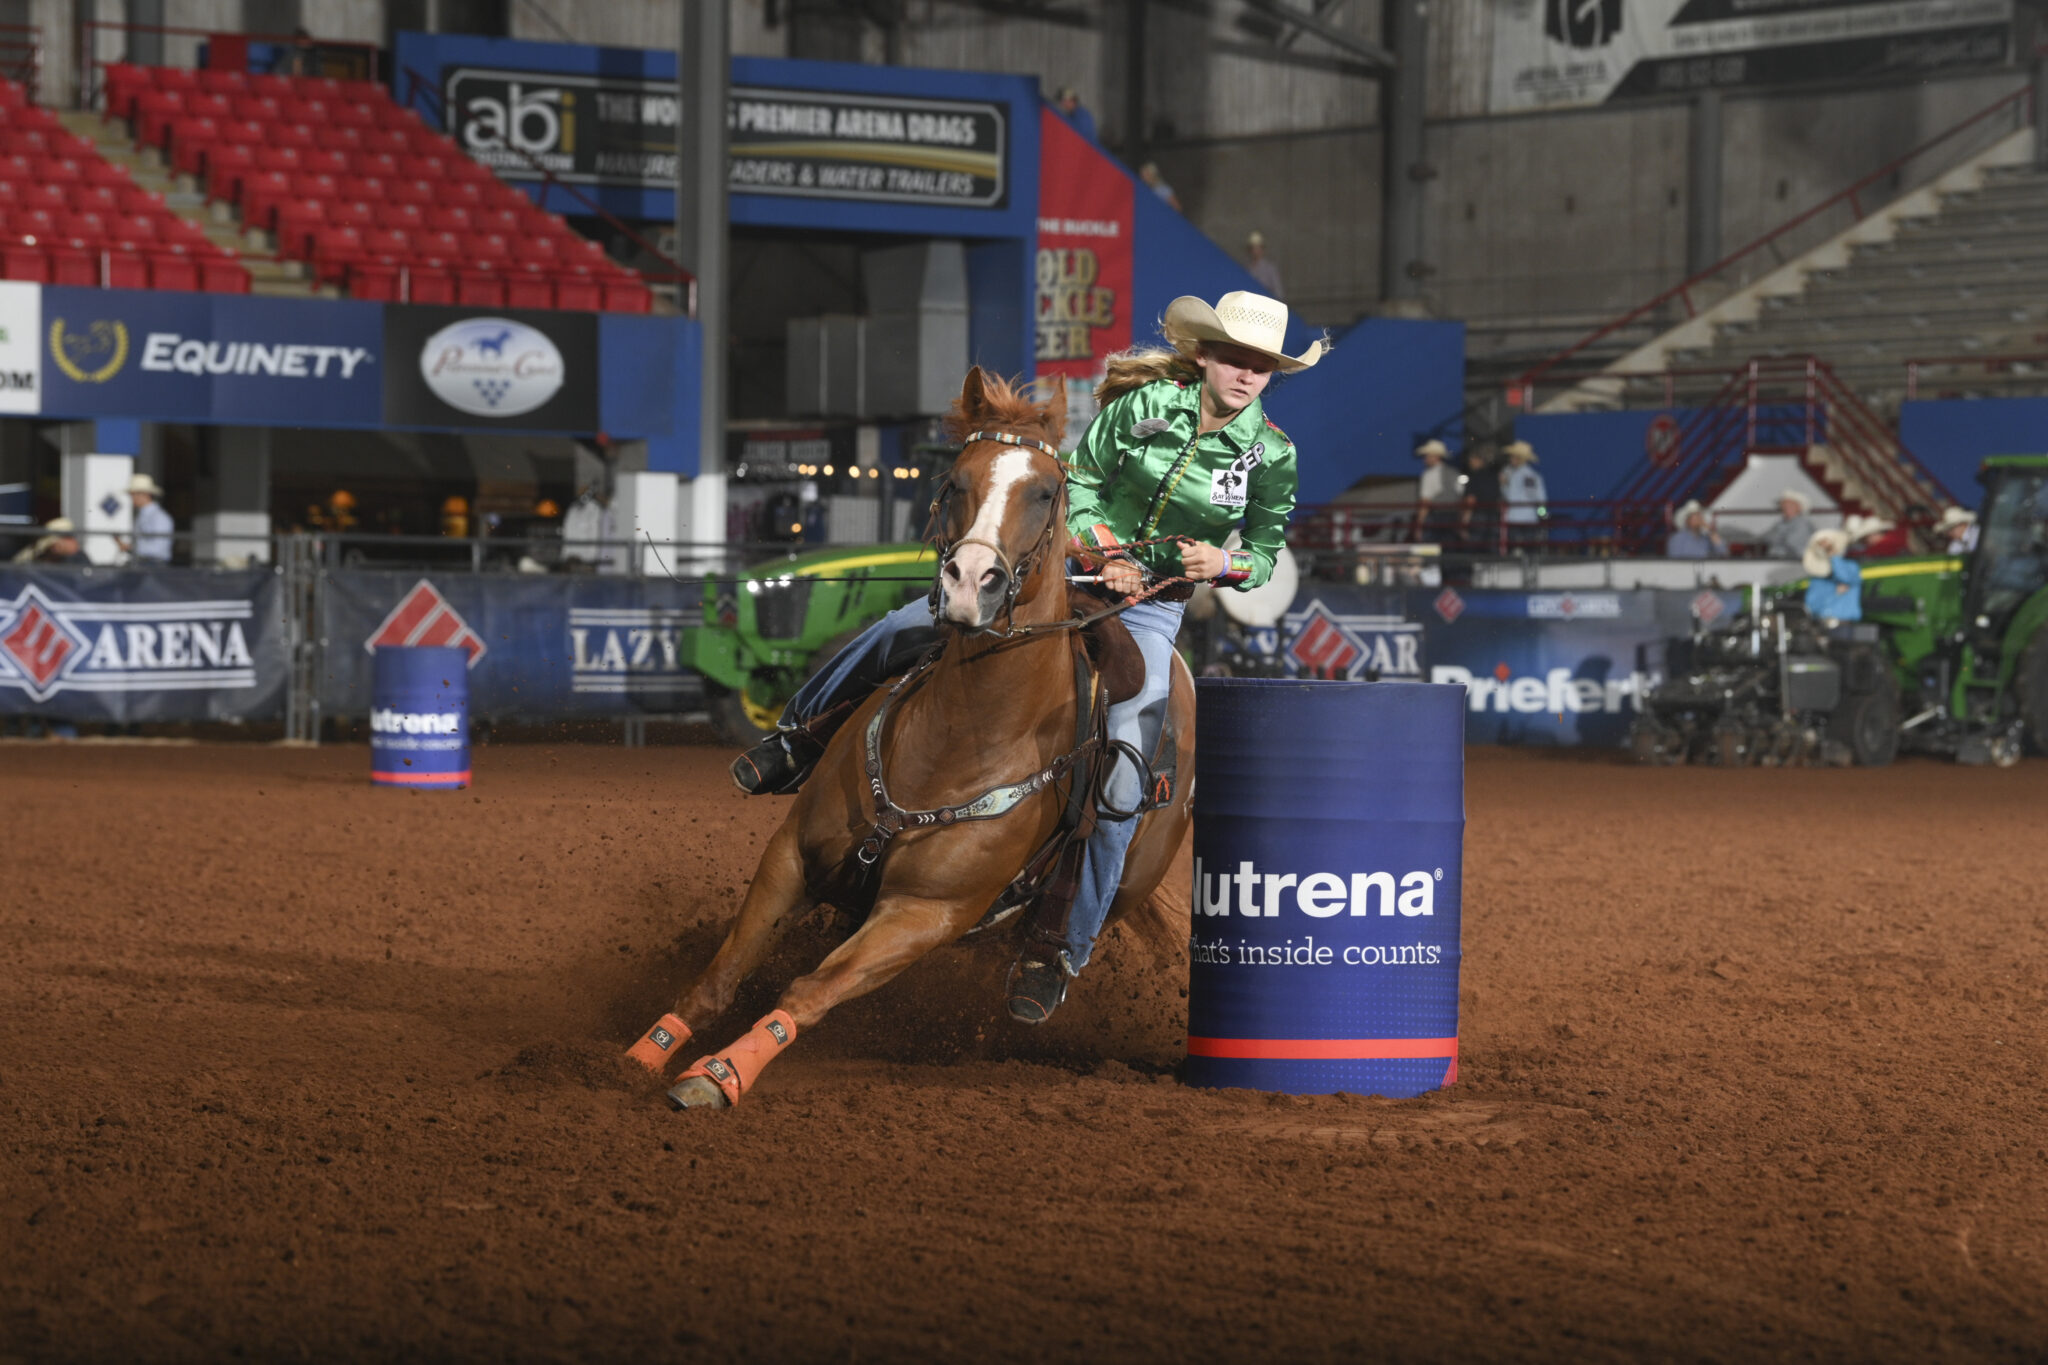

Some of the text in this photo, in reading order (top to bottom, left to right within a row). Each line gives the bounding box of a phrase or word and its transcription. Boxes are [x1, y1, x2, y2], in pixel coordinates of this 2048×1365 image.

[464, 83, 576, 155] abi
[739, 103, 832, 136] PREMIER
[835, 109, 905, 139] ARENA
[907, 114, 977, 145] DRAGS
[729, 160, 795, 187] ADERS
[801, 165, 816, 186] &
[819, 166, 882, 190] WATER
[886, 169, 975, 197] TRAILERS
[1036, 248, 1098, 286] OLD
[1035, 286, 1115, 328] CKLE
[141, 332, 366, 379] EQUINETY
[88, 622, 253, 669] ARENA
[571, 628, 683, 672] LAZY
[371, 706, 458, 734] utrena
[1239, 936, 1333, 964] inside
